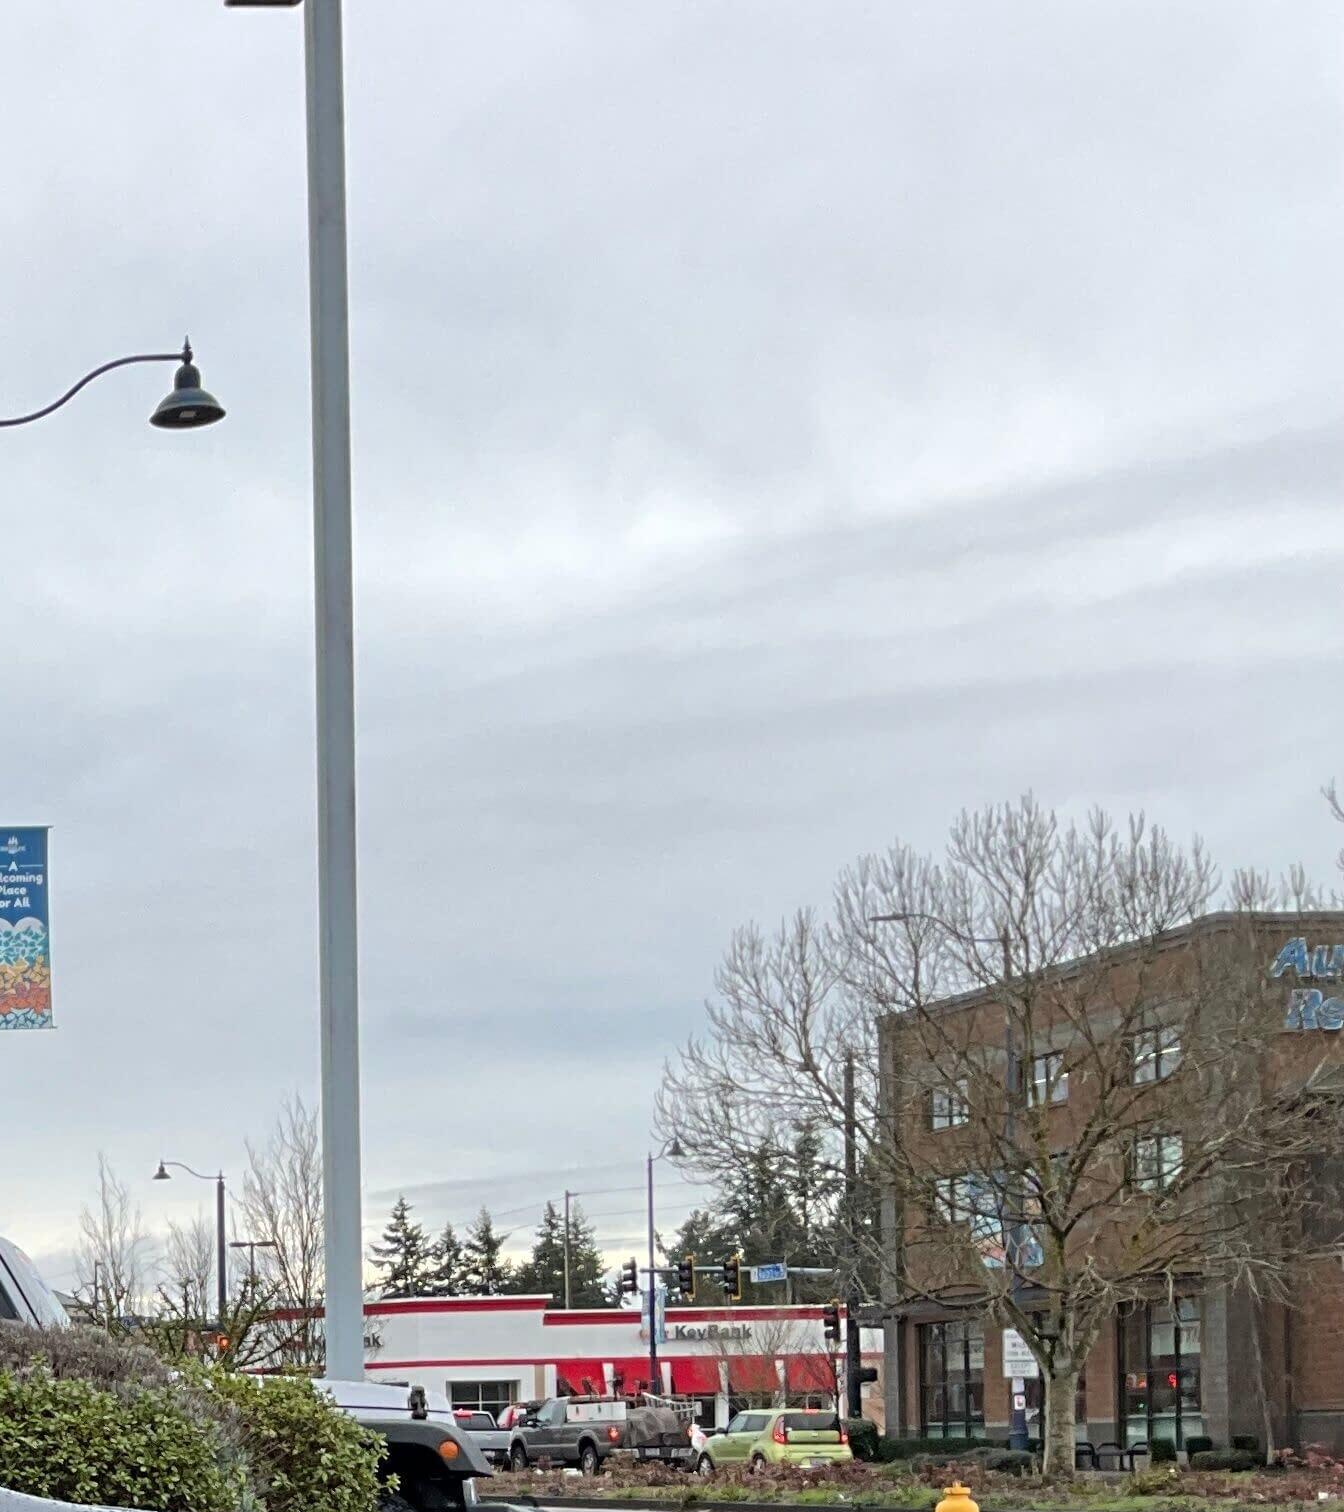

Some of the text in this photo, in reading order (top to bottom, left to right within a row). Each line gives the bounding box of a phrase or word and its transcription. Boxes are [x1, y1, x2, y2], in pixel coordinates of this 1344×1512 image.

[8, 860, 19, 872] A
[14, 896, 31, 908] All
[675, 1324, 752, 1340] KeyBank
